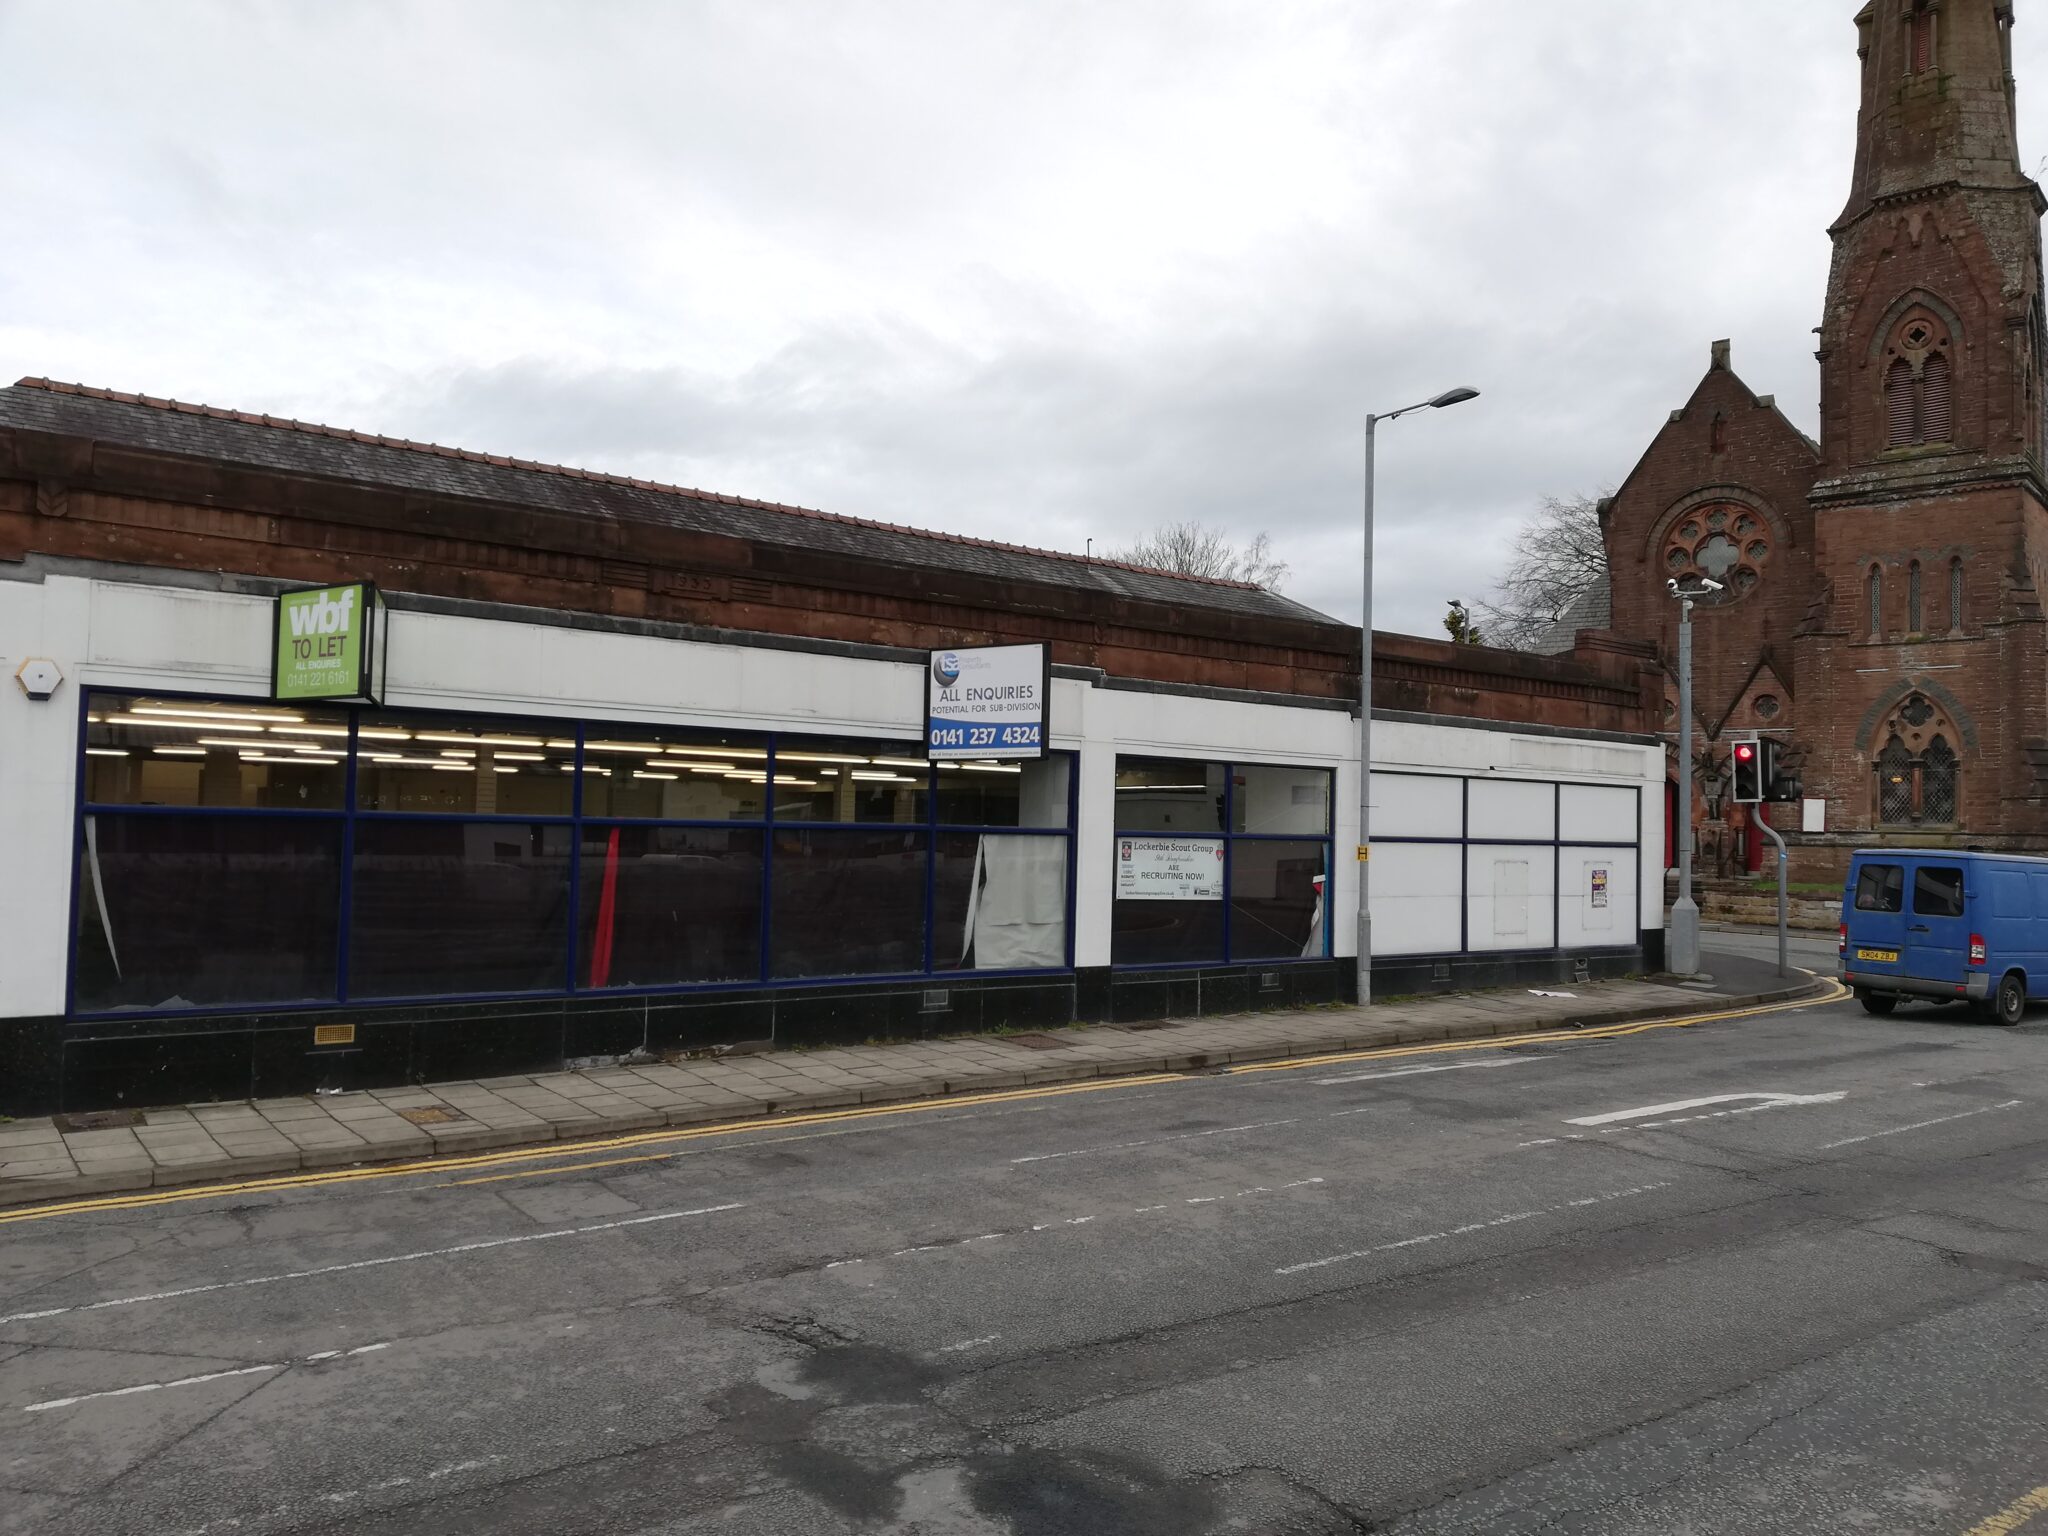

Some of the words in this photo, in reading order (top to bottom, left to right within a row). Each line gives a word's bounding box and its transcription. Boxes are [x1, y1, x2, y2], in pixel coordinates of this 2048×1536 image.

[289, 589, 354, 636] wbf
[292, 638, 311, 659] TO
[318, 635, 347, 657] LET
[295, 661, 306, 670] ALL
[308, 658, 342, 669] ENQUIRIES
[287, 673, 308, 687] 0141
[310, 672, 326, 686] 221
[328, 670, 349, 684] 6161
[940, 689, 960, 702] ALL
[966, 685, 1033, 701] ENQUIRIES
[932, 703, 969, 714] POTENTIAL
[971, 704, 986, 713] FOR
[989, 702, 1041, 712] SUB-DIVISION
[931, 728, 964, 745] 0141
[969, 727, 997, 745] 237
[1002, 726, 1040, 743] 4324
[1134, 842, 1169, 851] Lockerbie
[1171, 843, 1191, 852] Scout
[1192, 844, 1214, 854] Group
[1141, 872, 1183, 880] RECRUITING
